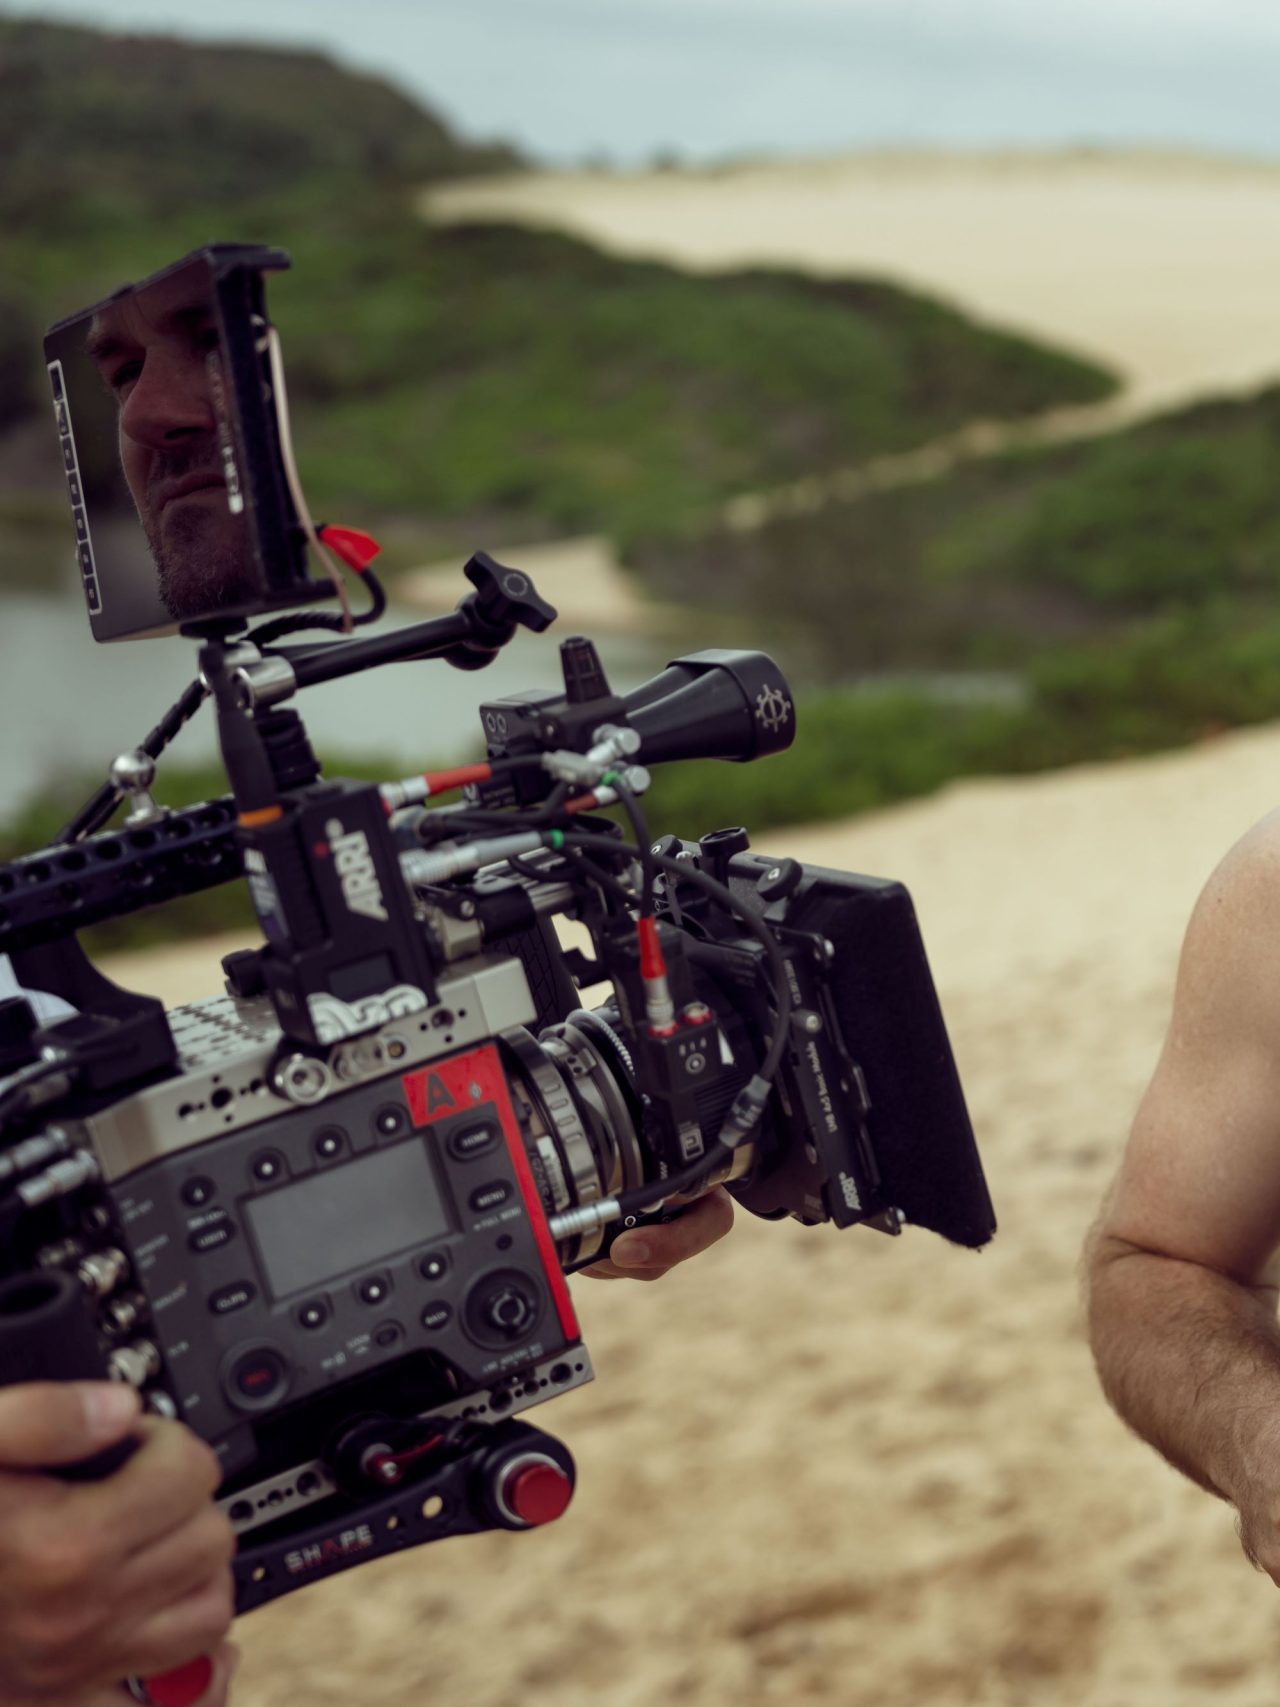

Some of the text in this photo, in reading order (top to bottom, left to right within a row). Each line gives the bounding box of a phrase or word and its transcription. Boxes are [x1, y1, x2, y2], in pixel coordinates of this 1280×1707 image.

[330, 830, 389, 921] ARRI
[427, 1071, 456, 1117] A
[284, 1523, 373, 1573] SHAPE
